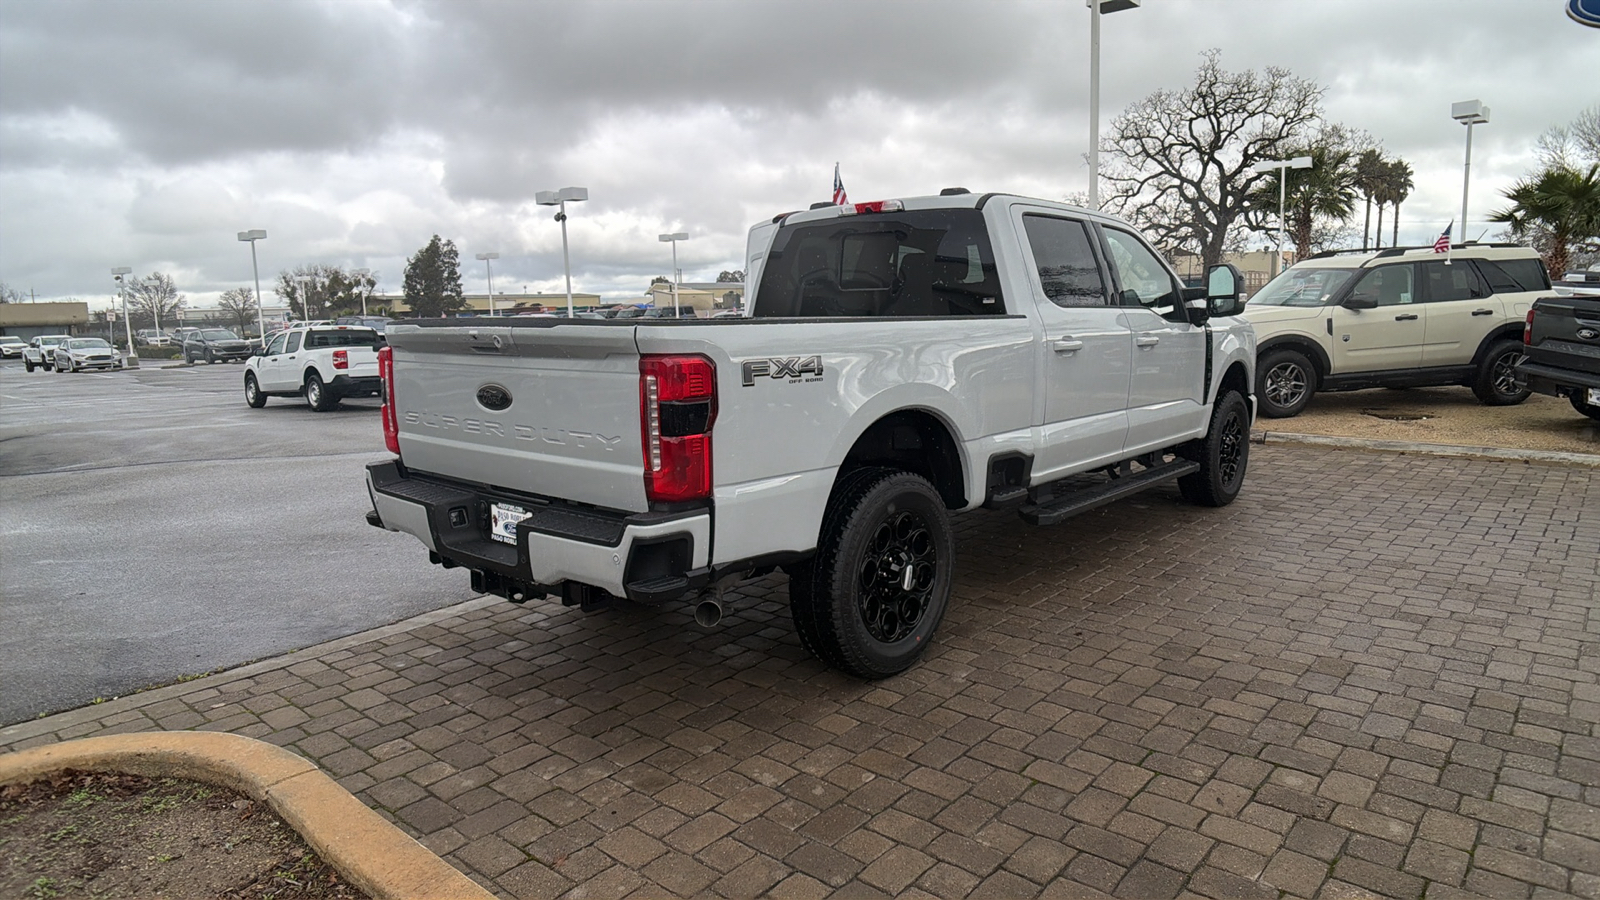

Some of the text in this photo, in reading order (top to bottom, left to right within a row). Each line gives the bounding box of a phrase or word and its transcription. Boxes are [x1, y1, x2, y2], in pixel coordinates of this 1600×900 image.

[741, 355, 823, 387] FX4
[405, 410, 622, 452] SUPER DUTY
[497, 510, 509, 521] PASO
[491, 533, 503, 541] PASO
